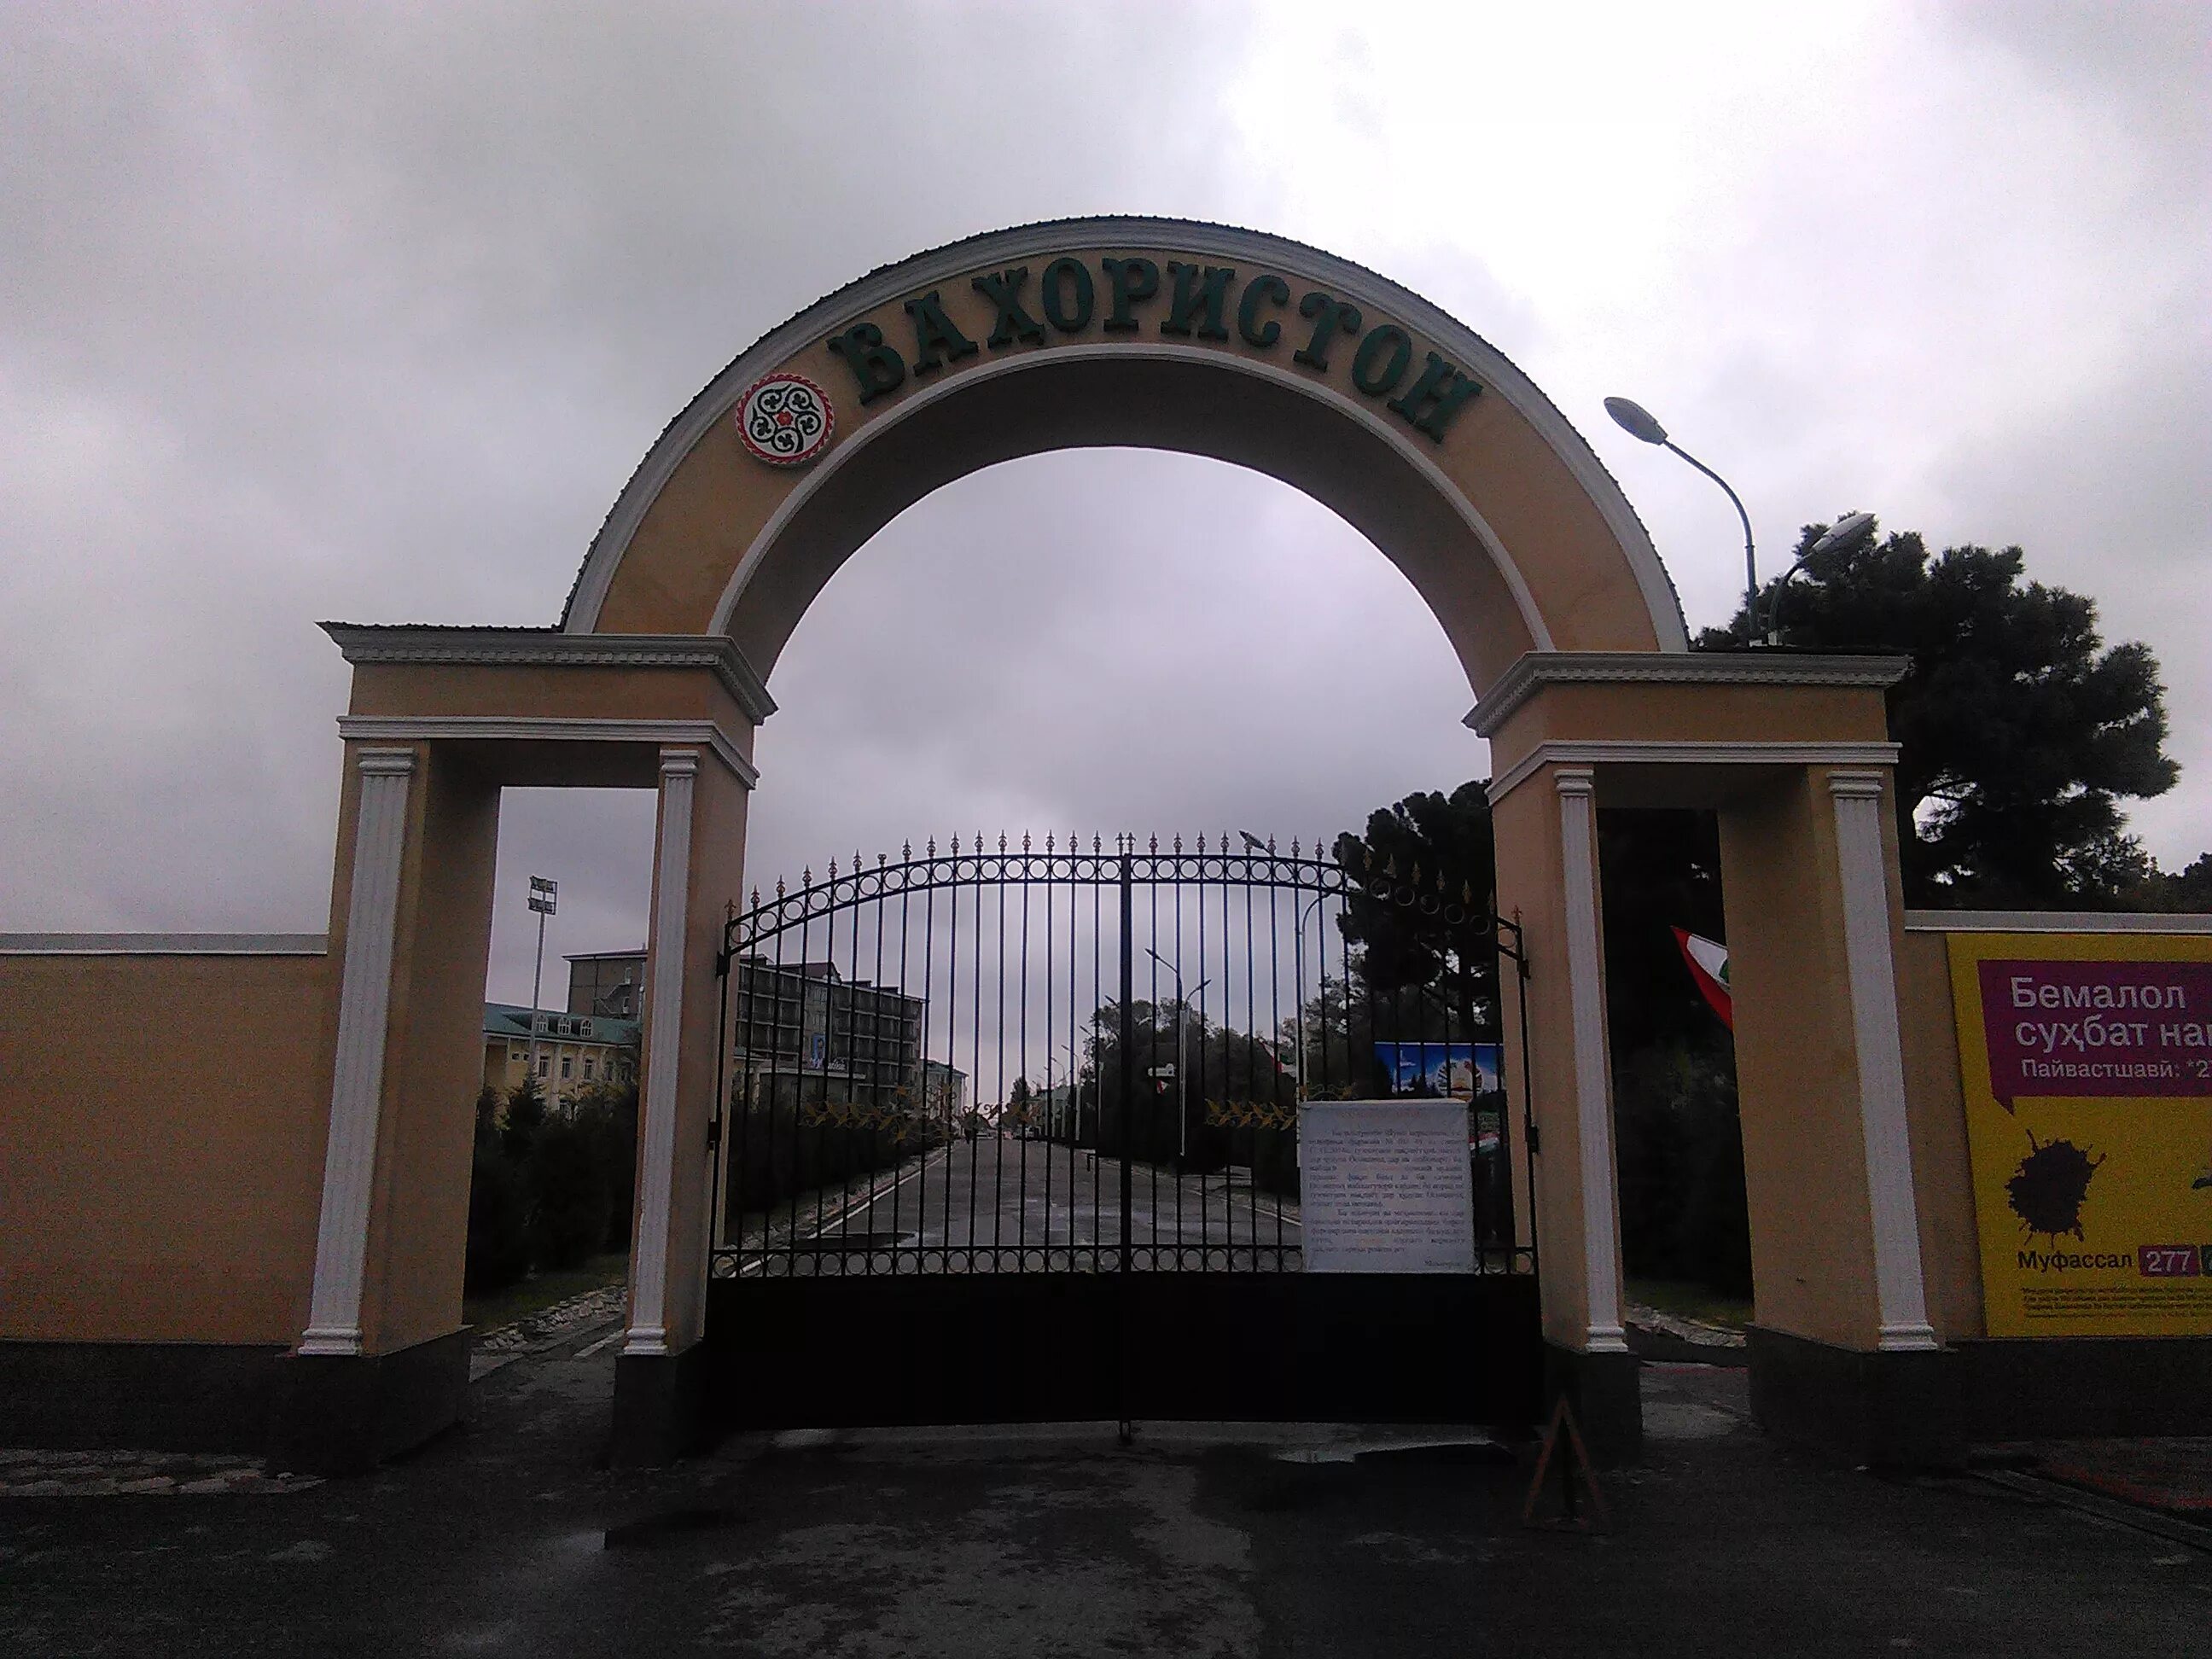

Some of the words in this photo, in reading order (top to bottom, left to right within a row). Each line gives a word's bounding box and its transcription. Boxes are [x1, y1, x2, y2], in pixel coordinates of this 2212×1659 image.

[2010, 976, 2186, 1010] Бемалол
[2015, 1013, 2149, 1053] суҳбат
[2017, 1250, 2133, 1273] Муфассал
[2145, 1250, 2192, 1272] 277
